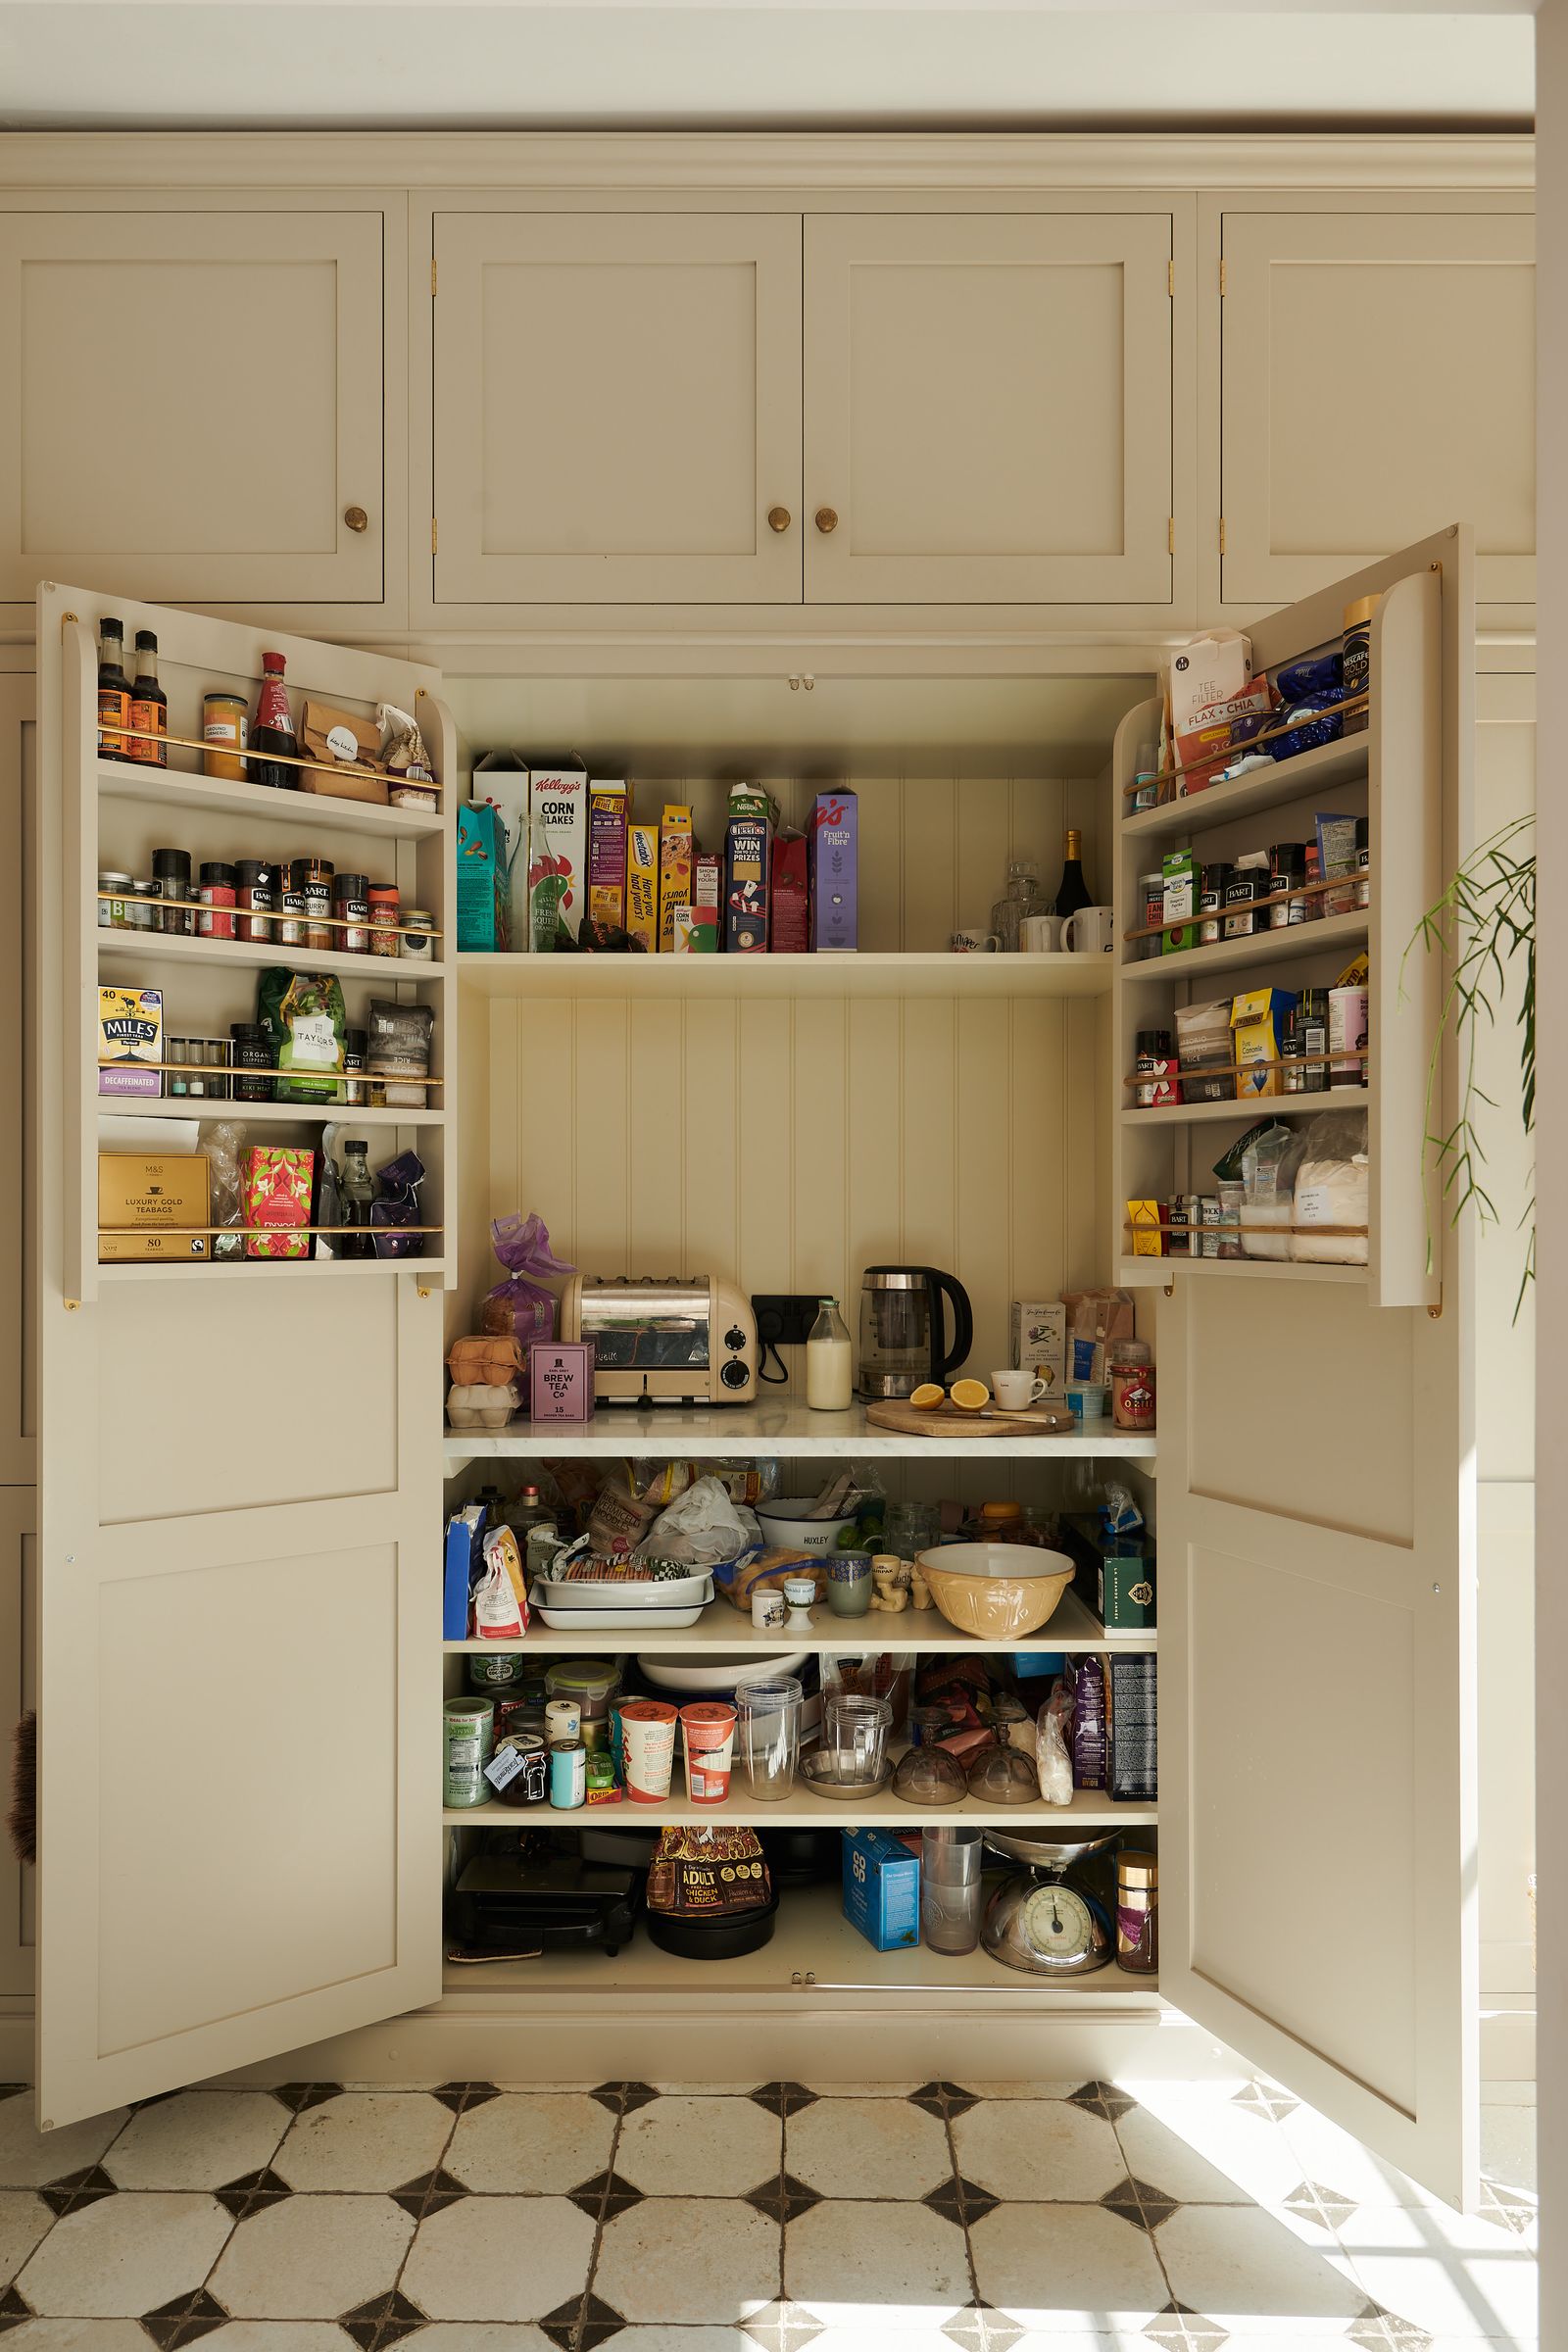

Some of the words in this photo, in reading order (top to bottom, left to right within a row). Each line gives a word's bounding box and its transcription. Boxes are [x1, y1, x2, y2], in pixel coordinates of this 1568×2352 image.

[1346, 661, 1367, 675] GOLD
[1199, 681, 1215, 692] TEE
[1192, 690, 1223, 704] FILTER
[1189, 710, 1215, 726] FLAX
[1226, 699, 1254, 713] CHIA
[535, 778, 581, 794] Kellogg's
[542, 803, 574, 814] CORN
[634, 831, 650, 867] Weetabix
[734, 840, 760, 851] WIN
[630, 873, 643, 893] had
[642, 878, 653, 899] Have
[1229, 887, 1250, 898] BART
[630, 890, 645, 920] yours?
[642, 898, 654, 917] you
[102, 991, 116, 1000] 40
[107, 1021, 155, 1037] MILES
[105, 1076, 154, 1086] DECAFFEINATED
[602, 1493, 618, 1505] RICE
[597, 1507, 630, 1532] NOODLES
[804, 1536, 829, 1544] HUXLEY
[683, 1871, 715, 1886] ADULT
[685, 1887, 718, 1897] CHICKEN
